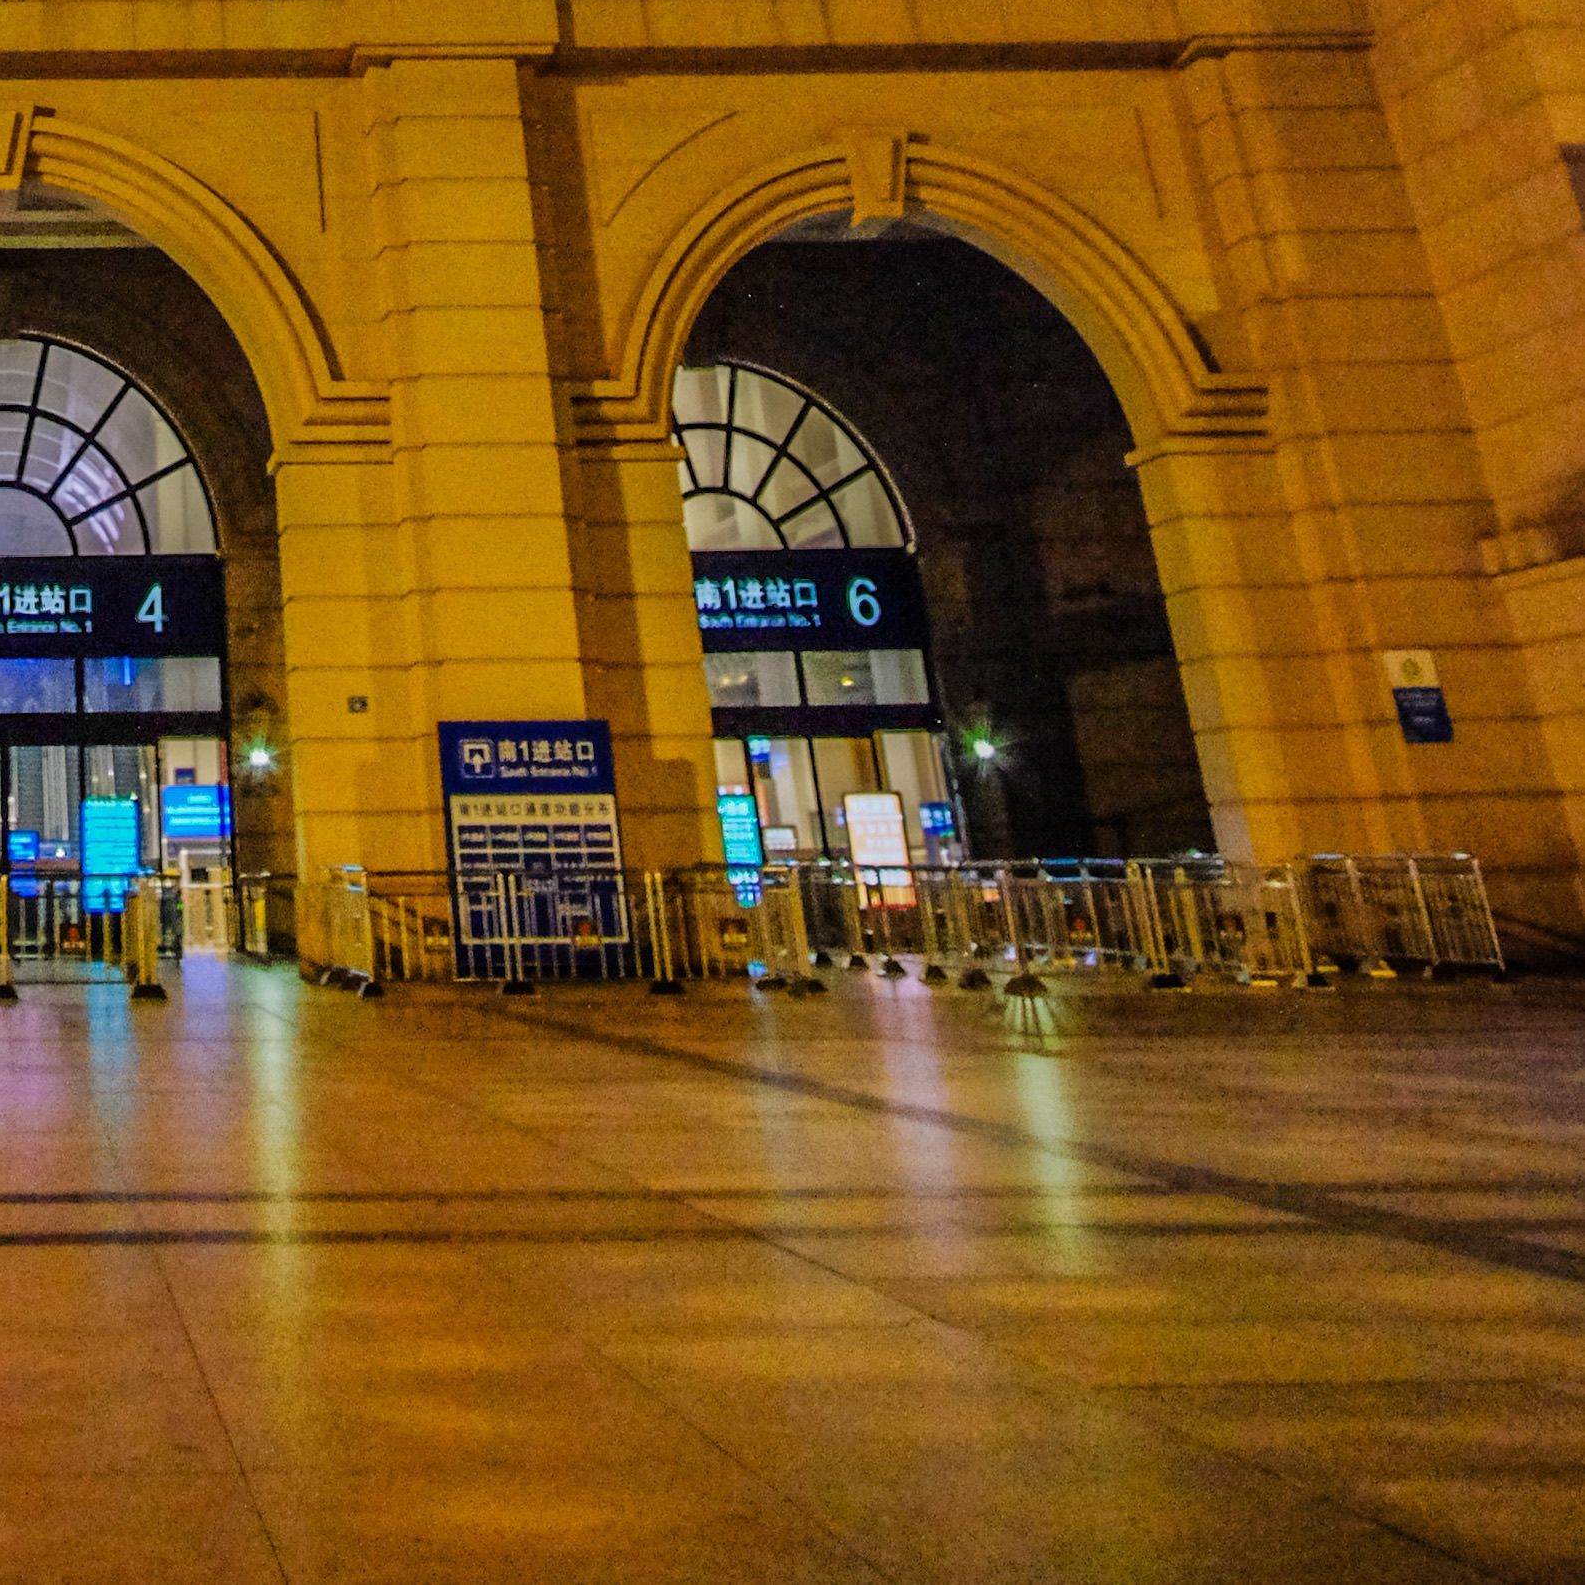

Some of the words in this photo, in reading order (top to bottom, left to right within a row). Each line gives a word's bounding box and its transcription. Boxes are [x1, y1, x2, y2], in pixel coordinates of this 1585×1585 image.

[135, 583, 165, 634] 4
[694, 577, 819, 610] 南1进站口
[847, 577, 882, 627] 6
[7, 618, 58, 634] Entrance
[498, 738, 594, 763] 南1进站口
